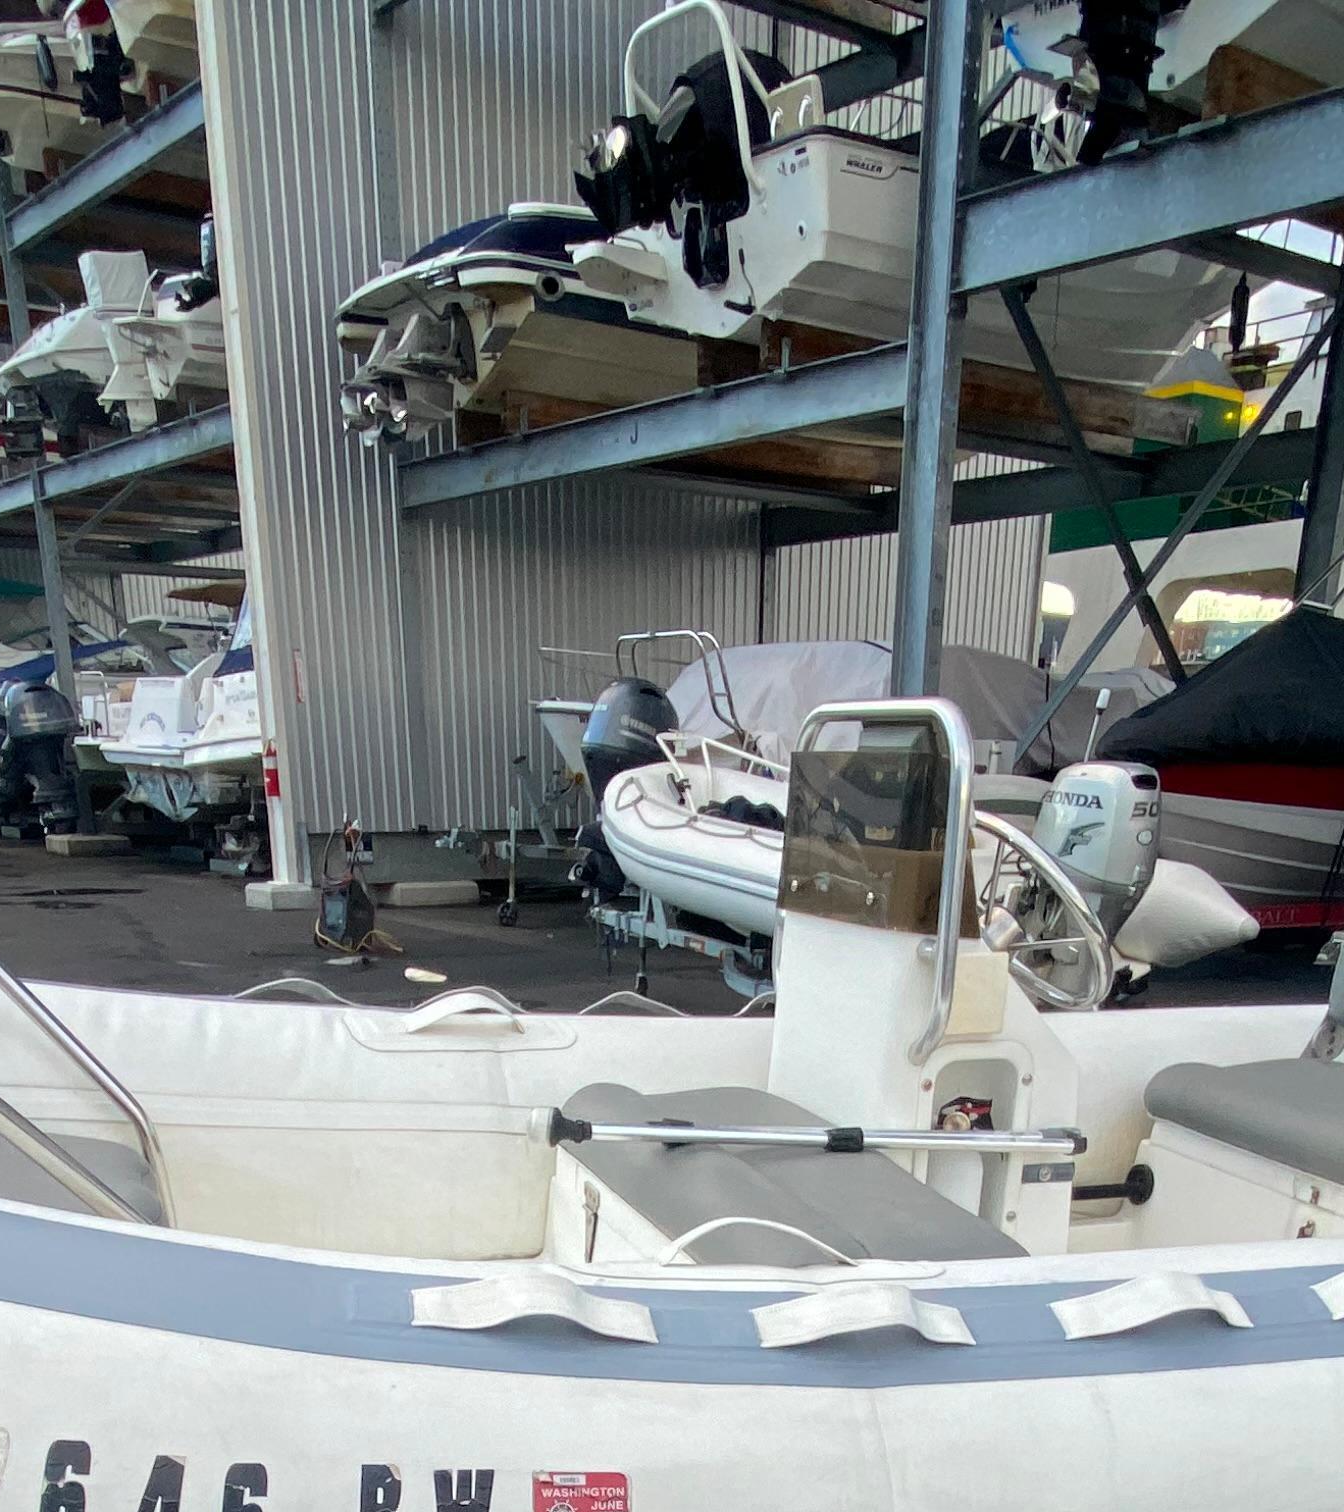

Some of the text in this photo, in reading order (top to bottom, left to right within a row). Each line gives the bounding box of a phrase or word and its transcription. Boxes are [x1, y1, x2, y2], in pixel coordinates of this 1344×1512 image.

[1042, 790, 1103, 809] HONDA
[541, 1487, 625, 1498] WASHINGTON
[591, 1501, 624, 1511] JUNE
